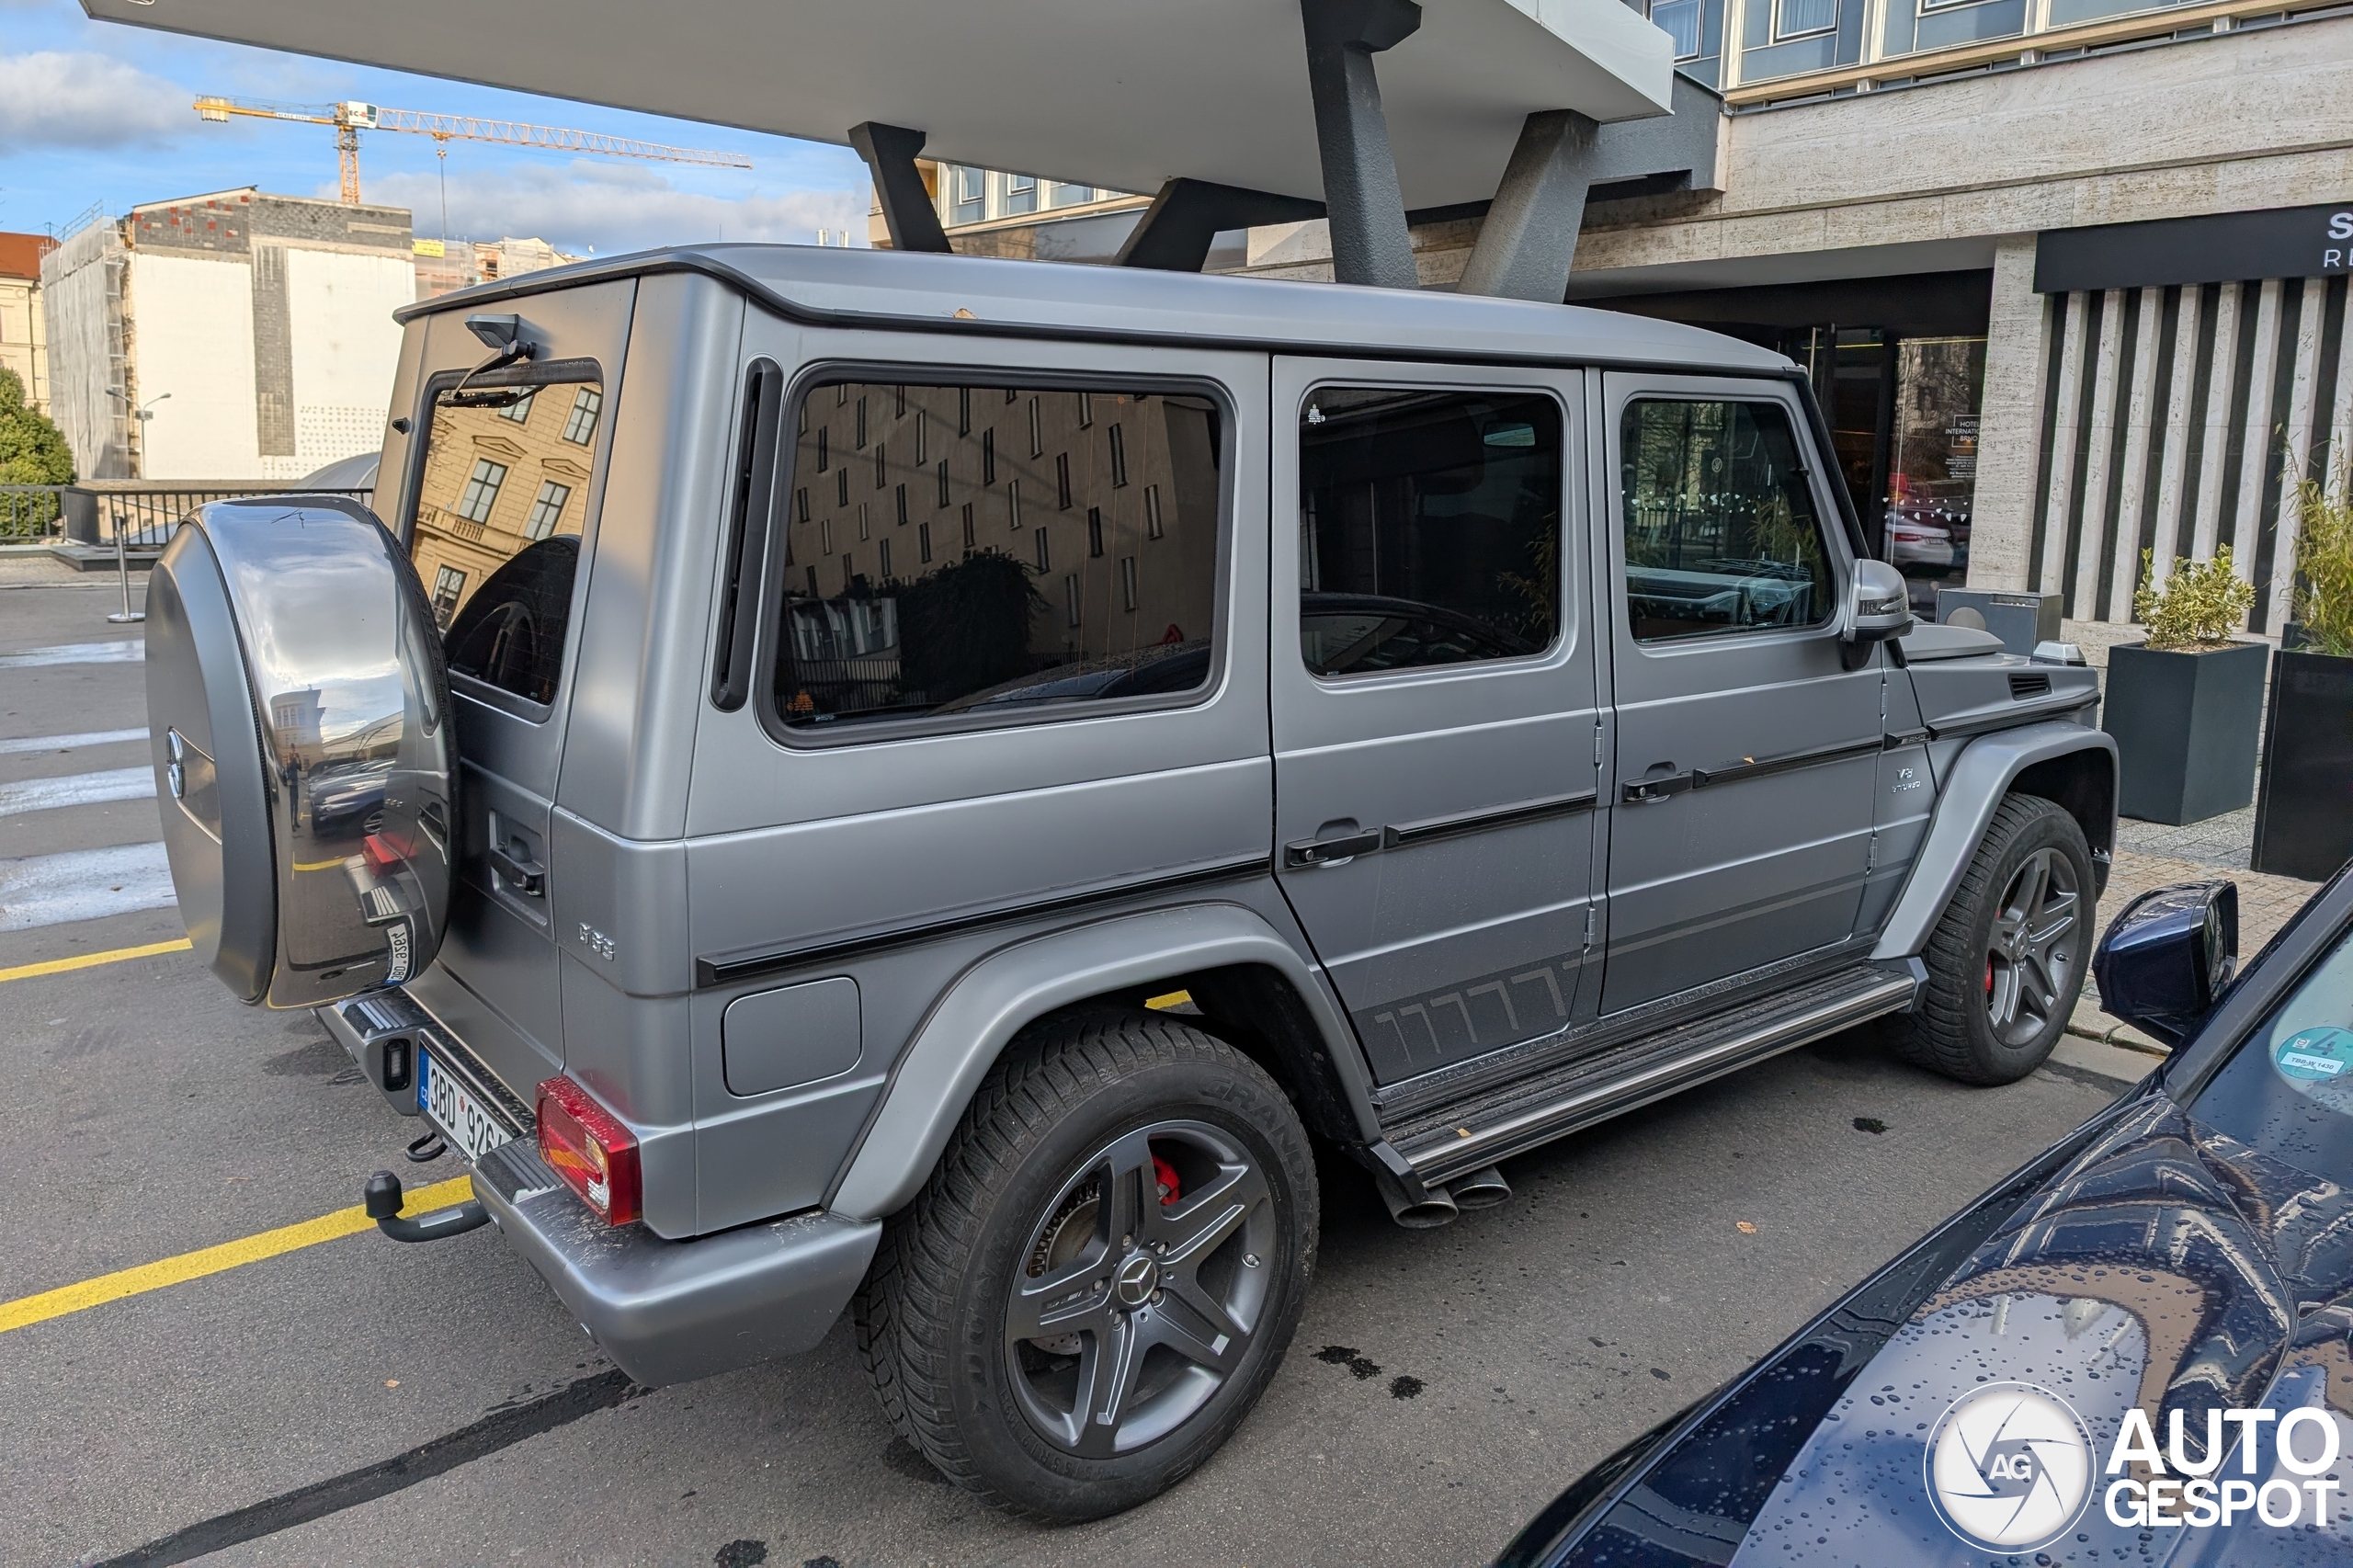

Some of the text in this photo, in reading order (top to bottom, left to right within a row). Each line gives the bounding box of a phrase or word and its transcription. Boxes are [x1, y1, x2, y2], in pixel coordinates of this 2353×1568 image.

[2310, 1030, 2340, 1056] 4
[2317, 1062, 2335, 1070] 1430
[420, 1085, 428, 1103] CZ
[430, 1068, 456, 1131] 3BD
